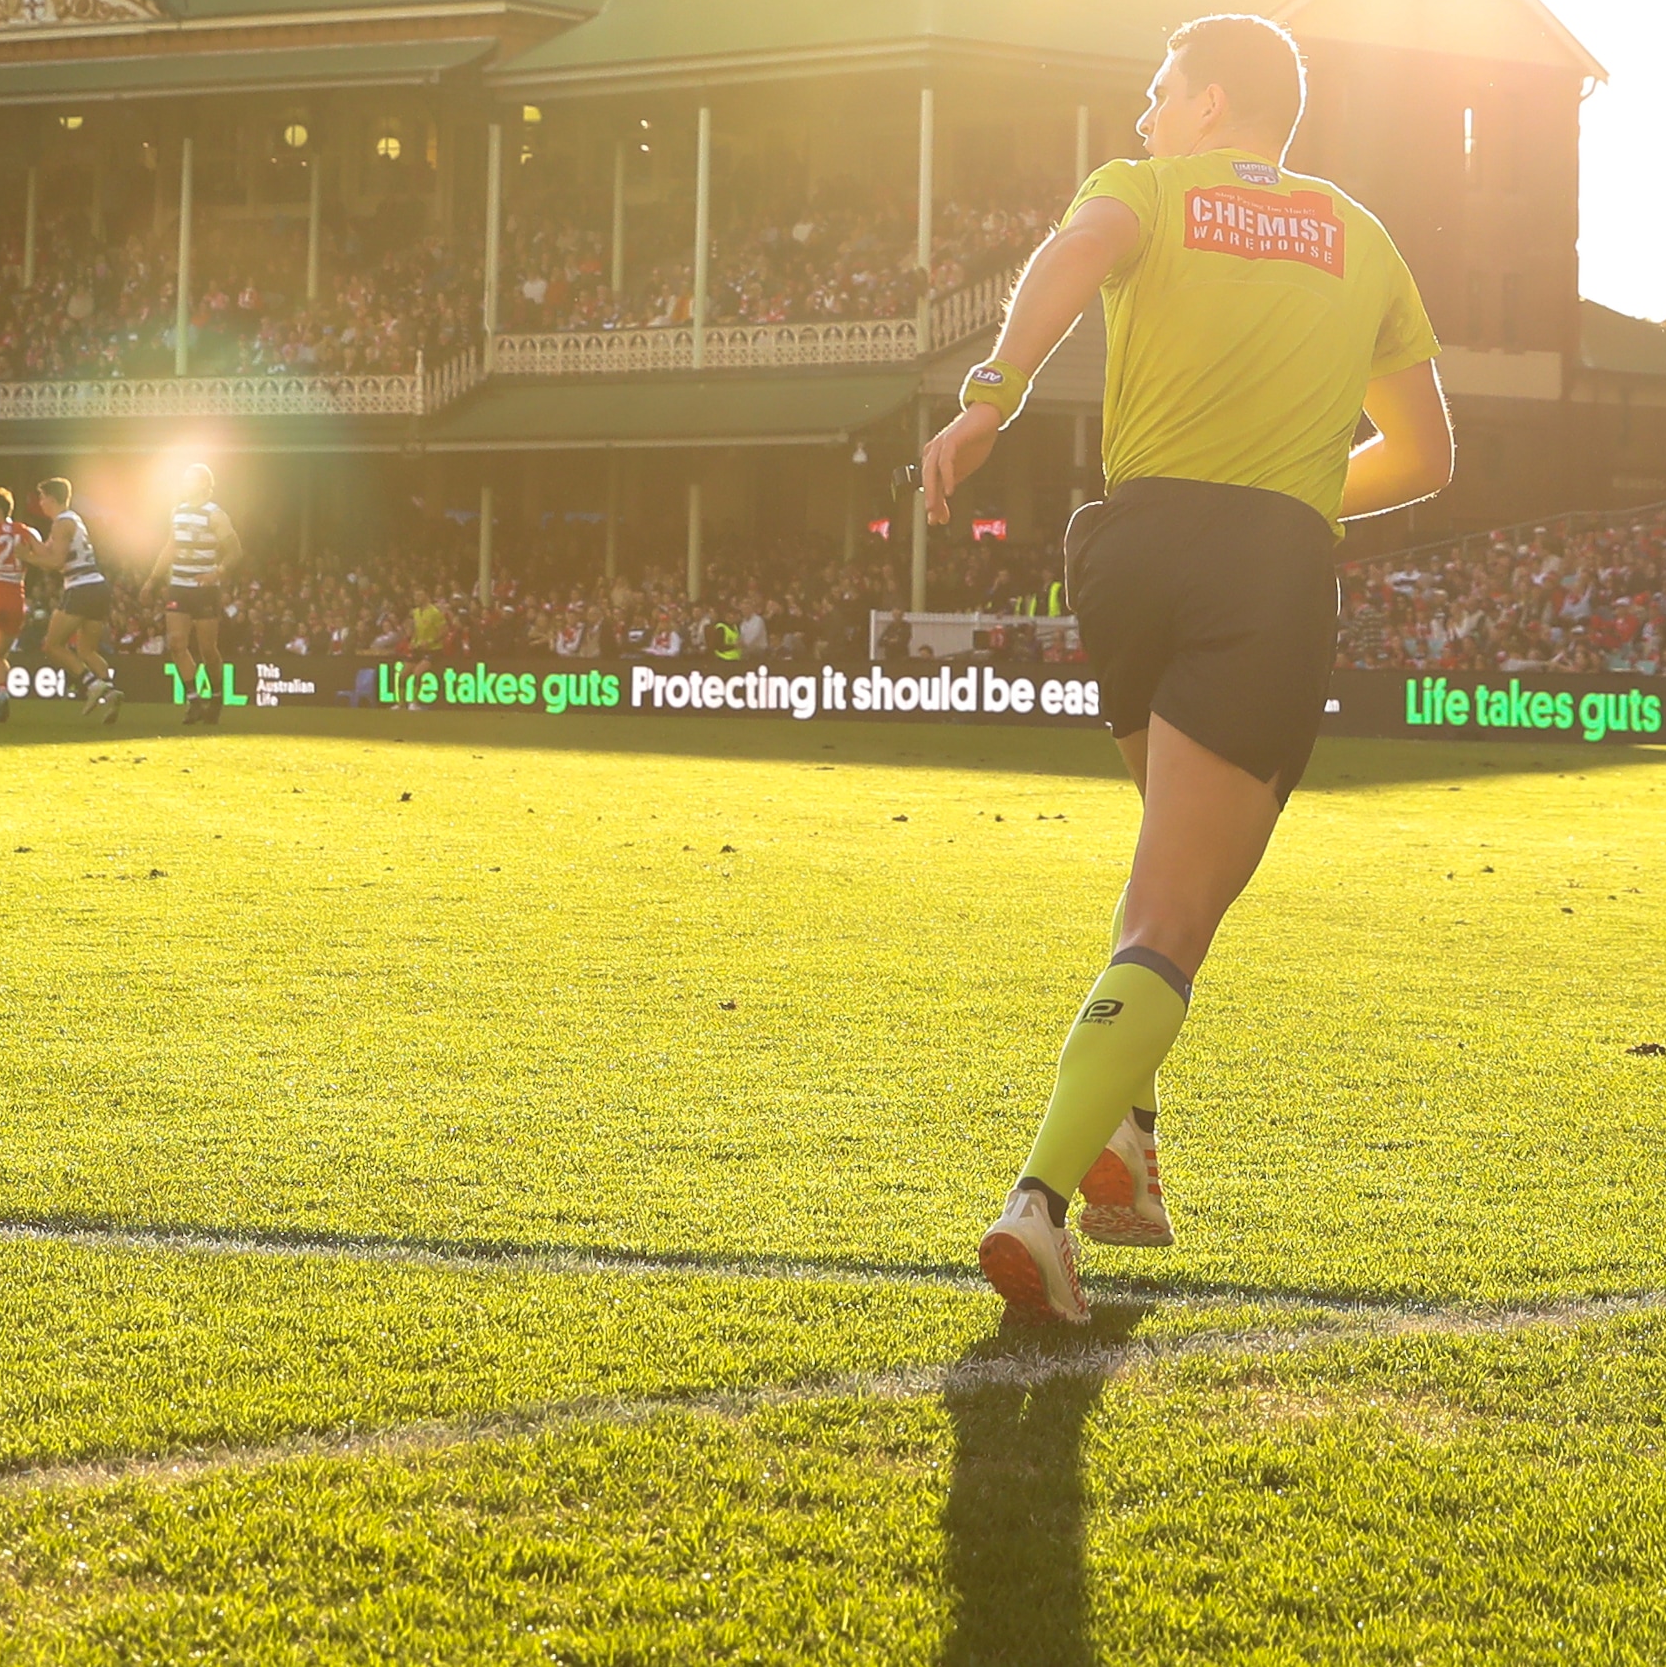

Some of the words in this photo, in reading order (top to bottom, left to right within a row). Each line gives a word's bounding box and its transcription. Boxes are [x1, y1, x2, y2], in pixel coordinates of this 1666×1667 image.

[1192, 195, 1338, 248] CHEMIST
[1193, 225, 1333, 265] WAREHOUSE
[256, 663, 280, 679] This
[256, 678, 315, 694] Australian
[443, 662, 536, 705] takes
[542, 670, 620, 714] guts
[631, 665, 817, 720] Protecting
[822, 665, 847, 711] it
[852, 666, 978, 712] should
[983, 666, 1035, 714] be
[1040, 679, 1100, 716] eas
[256, 693, 279, 707] Life
[1405, 676, 1471, 726] Life
[1475, 678, 1575, 729] takes
[1579, 689, 1663, 742] guts
